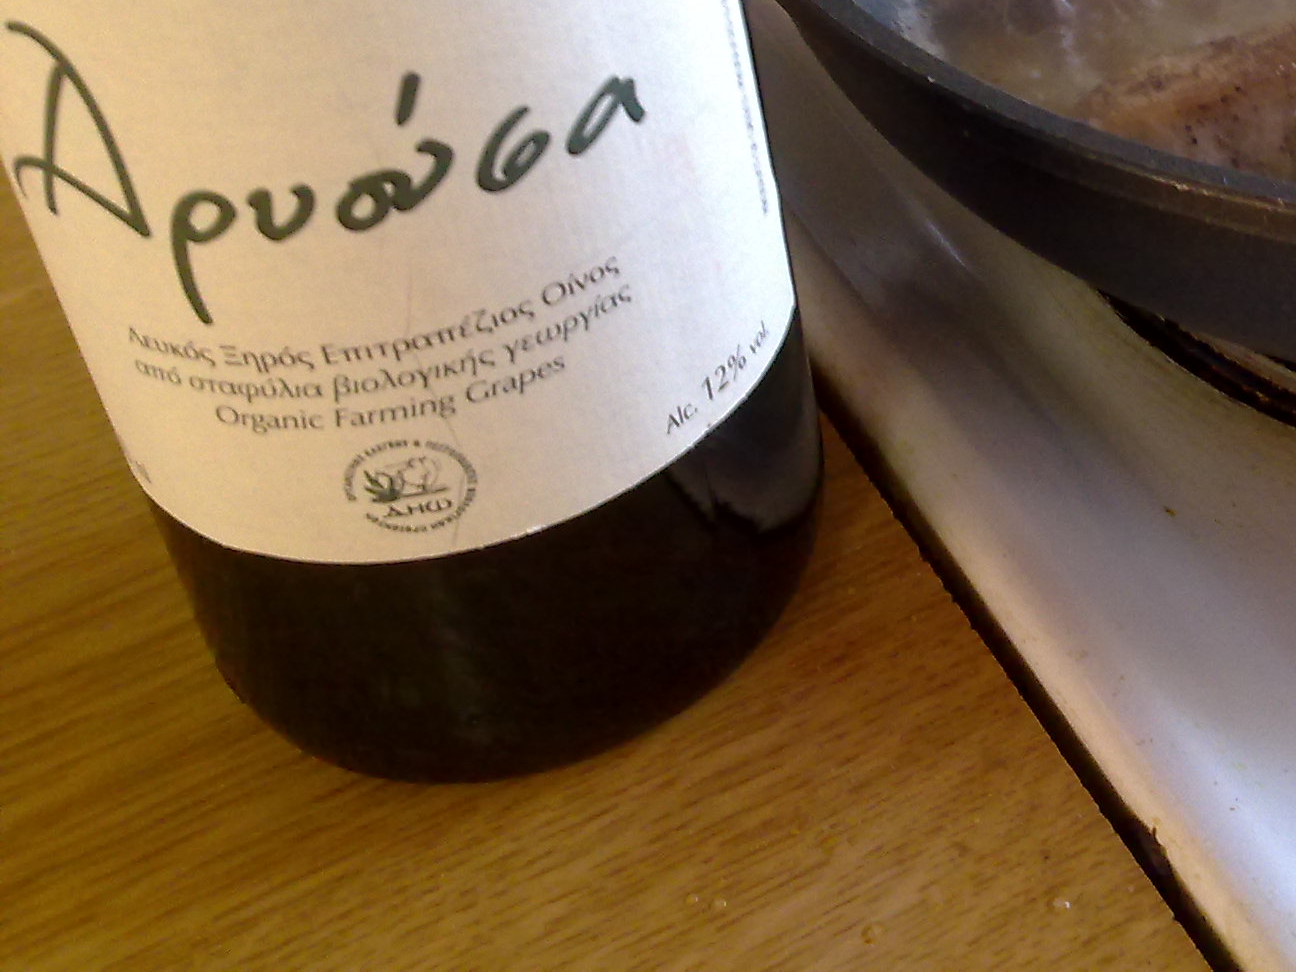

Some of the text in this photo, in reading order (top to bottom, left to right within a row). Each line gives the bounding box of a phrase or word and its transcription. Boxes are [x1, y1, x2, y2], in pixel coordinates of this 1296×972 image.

[128, 256, 620, 373] Λευκός Ξηρός Επιτραπέζιος Οίνος
[135, 284, 632, 404] από σταφύλια βιολογικής γεωργίας
[215, 355, 566, 434] Organic Farming Grapes
[666, 402, 699, 435] Alc.
[701, 343, 748, 402] 12%
